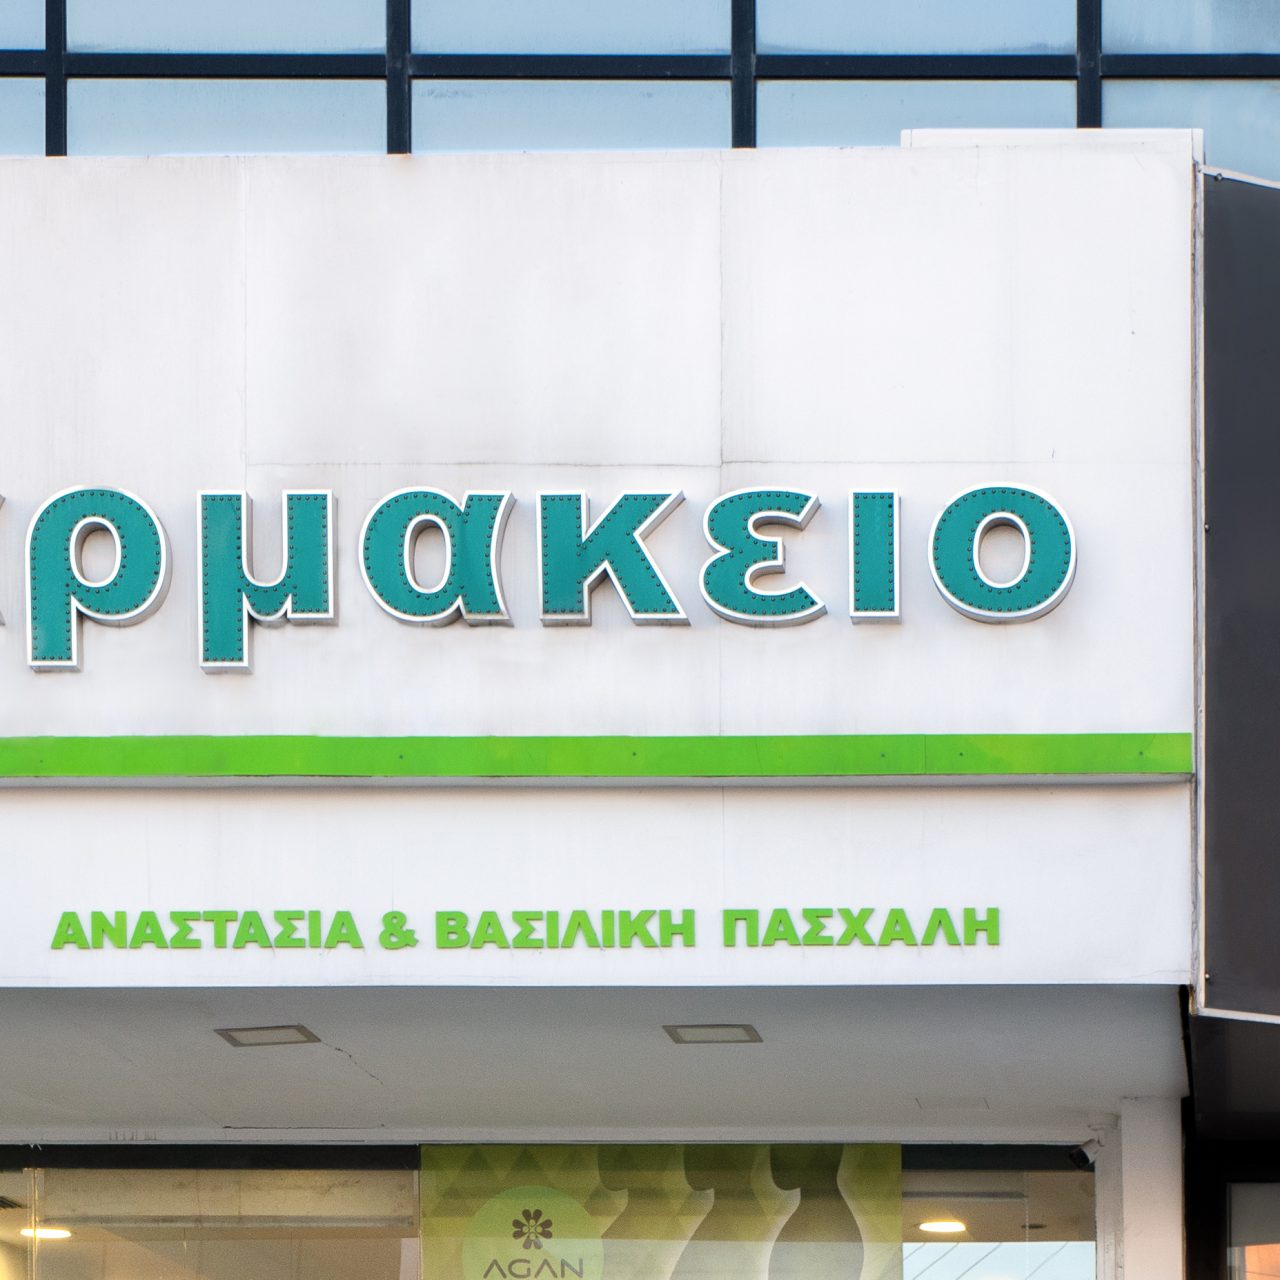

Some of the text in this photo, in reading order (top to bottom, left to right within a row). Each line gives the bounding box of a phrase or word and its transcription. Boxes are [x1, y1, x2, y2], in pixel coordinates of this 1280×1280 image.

[51, 908, 1000, 950] ΑΝΑΣΤΑΣΙΑ & ΒΑΣΙΛΙΚΗ ΠΑΣΧΑΛΗ
[483, 1258, 583, 1279] AGAN
